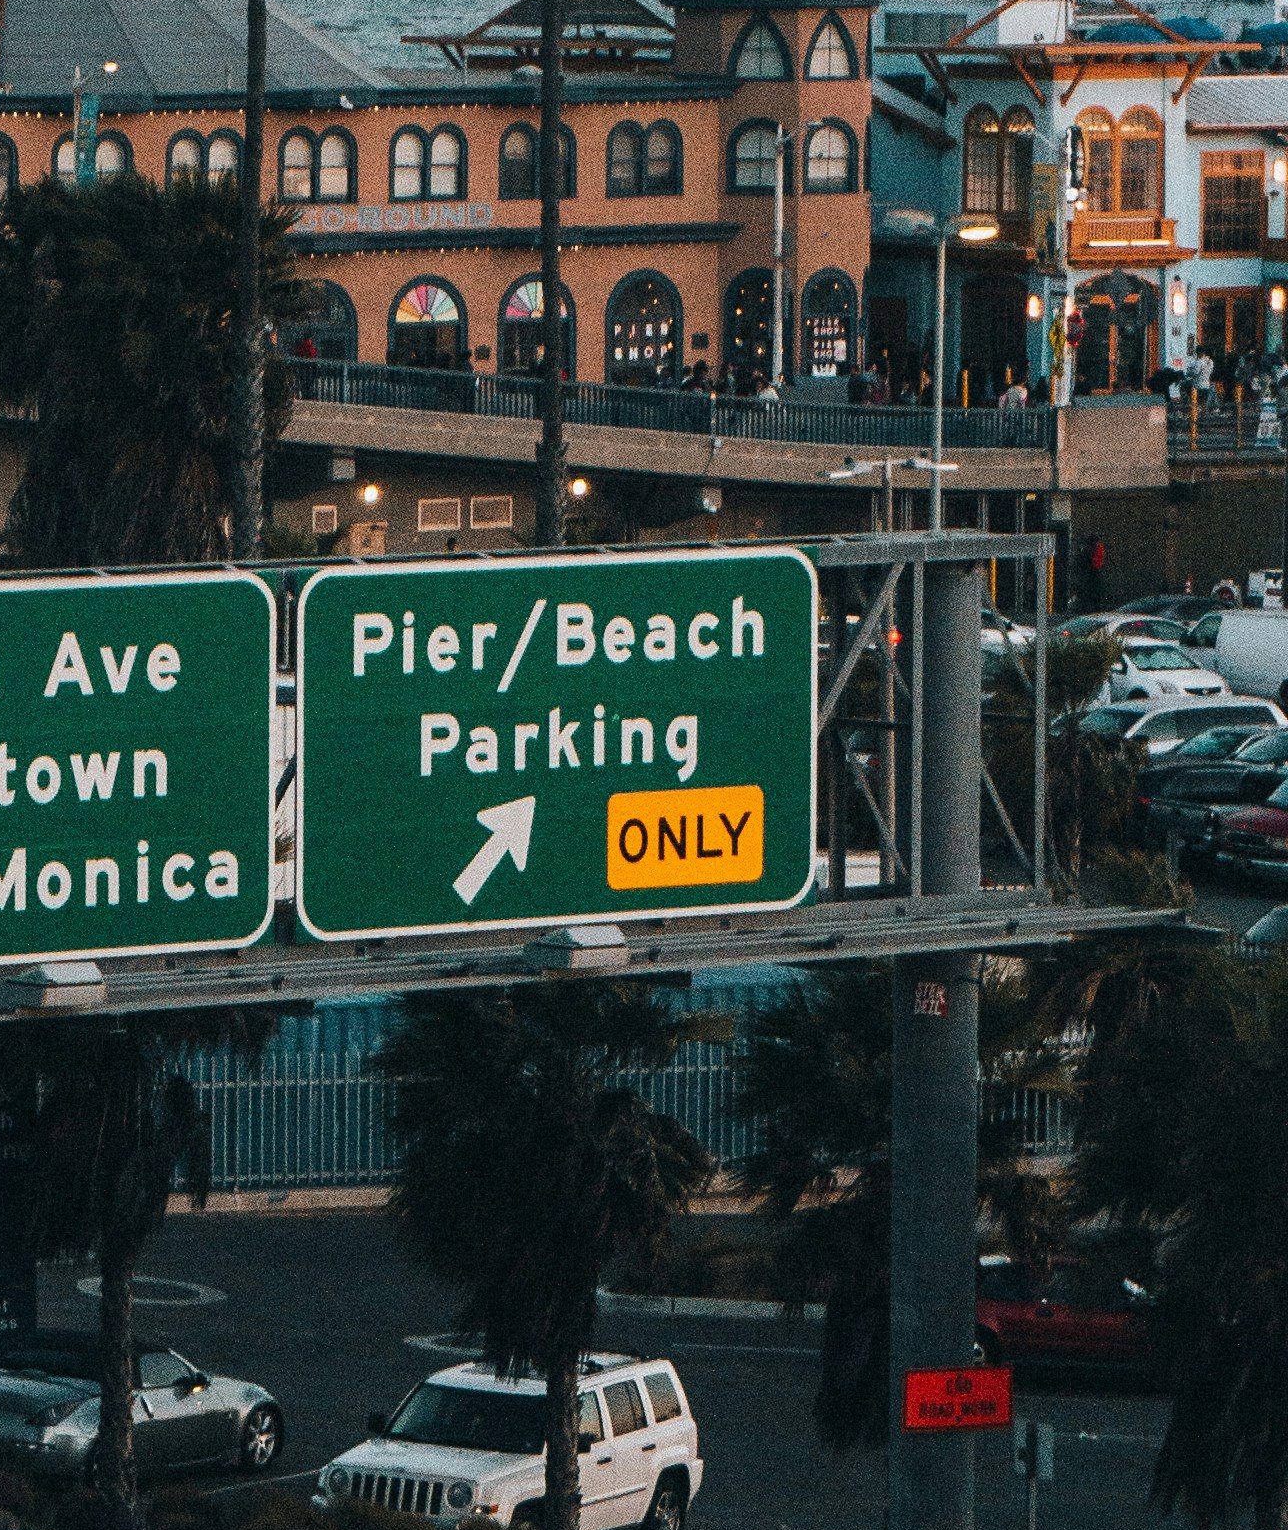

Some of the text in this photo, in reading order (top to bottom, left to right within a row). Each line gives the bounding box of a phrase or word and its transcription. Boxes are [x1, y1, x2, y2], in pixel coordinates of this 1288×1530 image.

[614, 345, 668, 361] SHOP
[44, 631, 181, 697] Ave
[353, 595, 765, 692] Pier/Beach
[420, 704, 698, 782] Parking
[619, 812, 750, 863] ONLY
